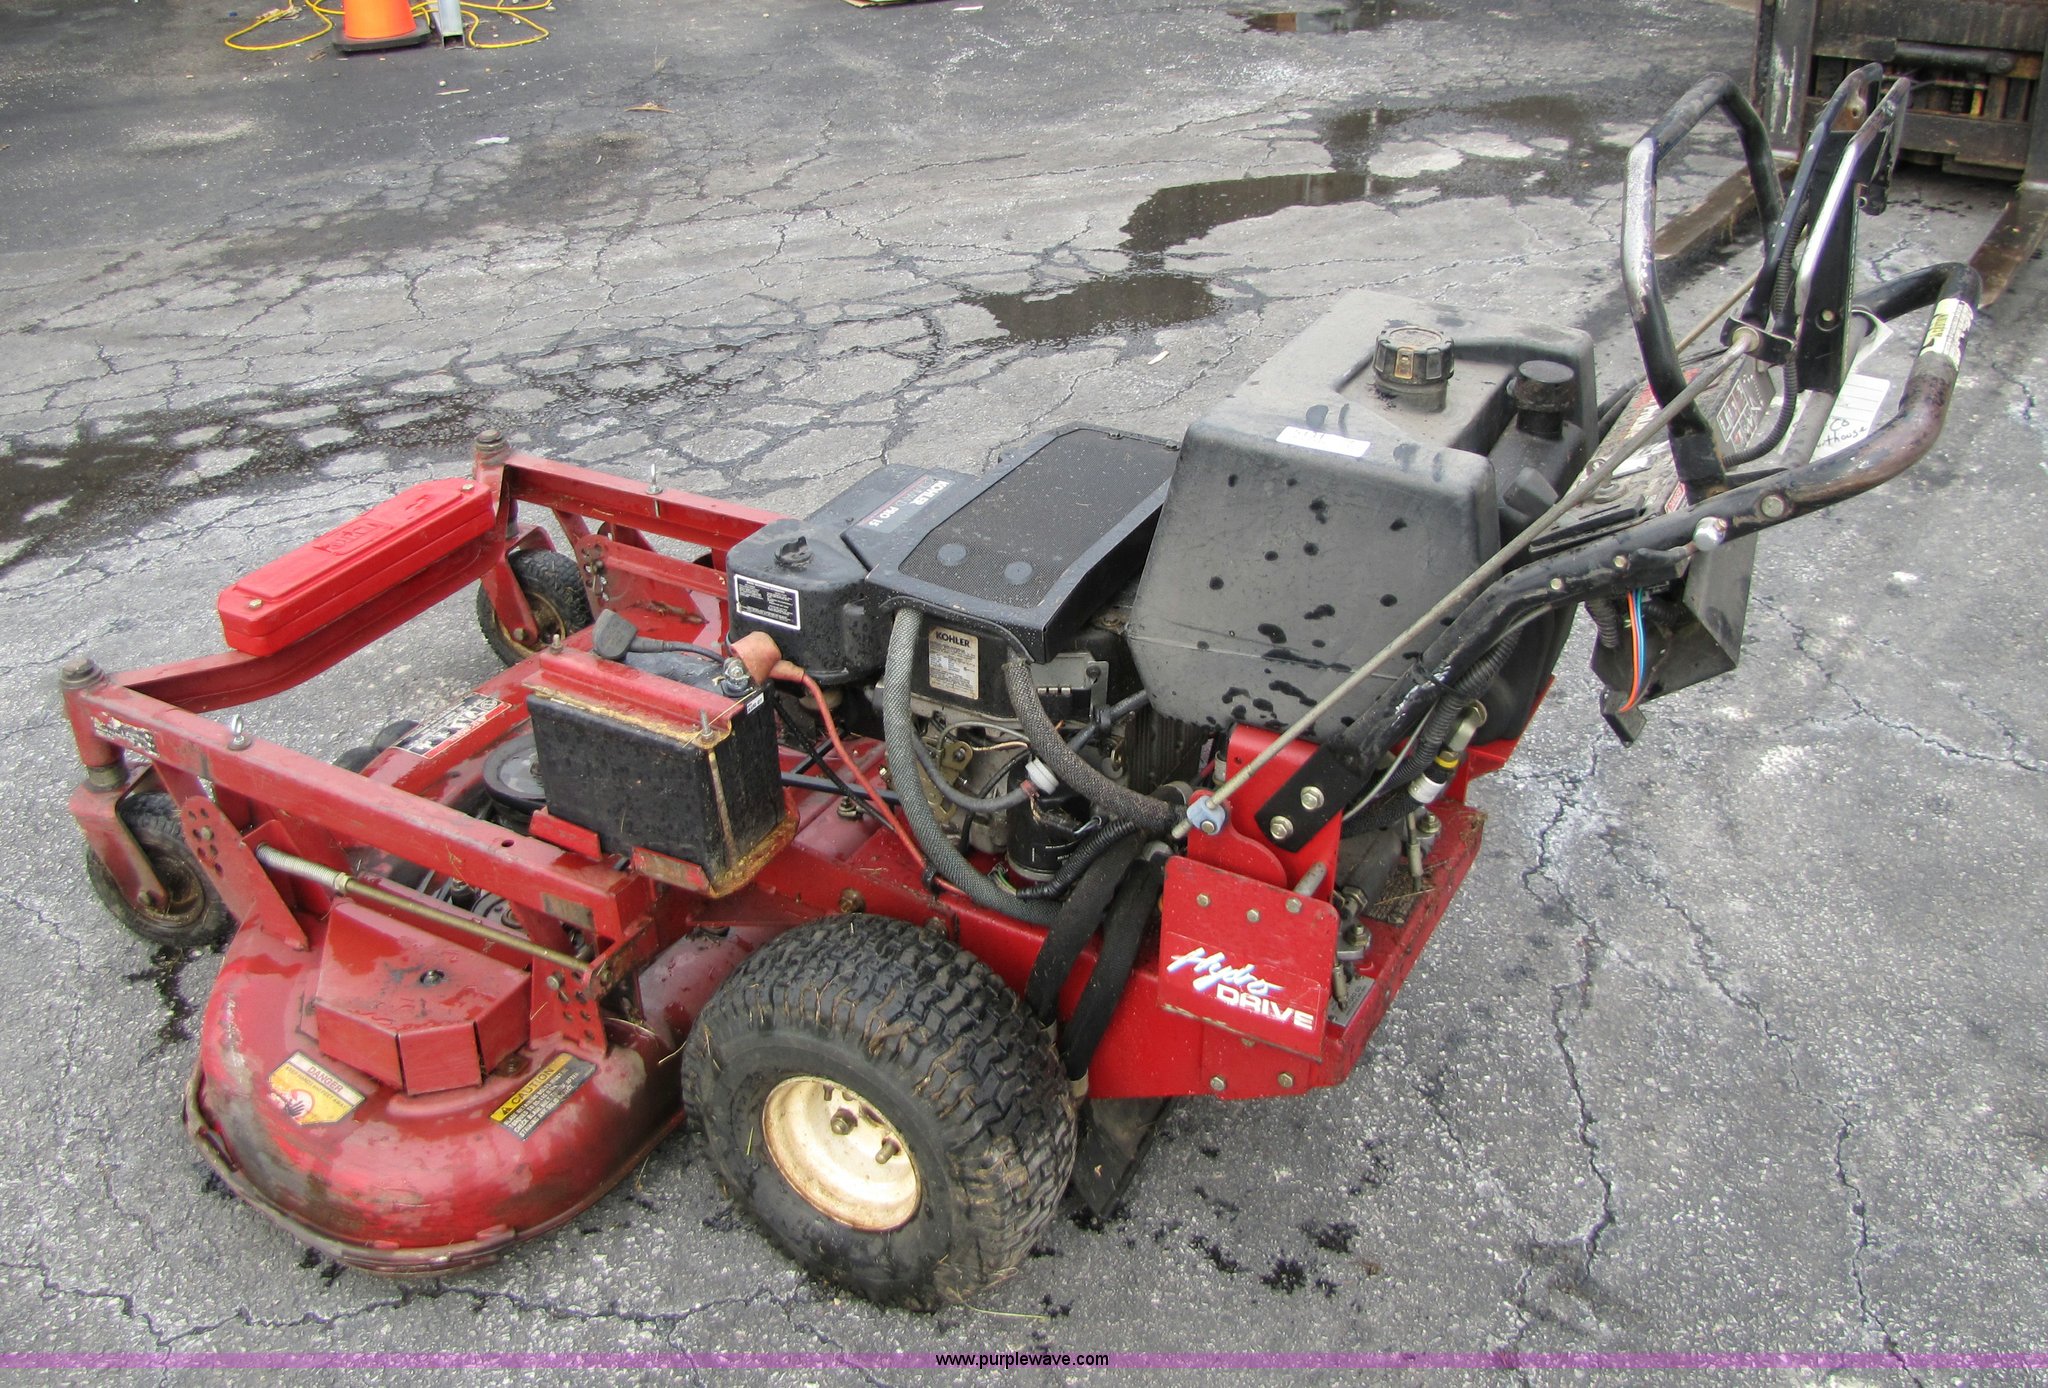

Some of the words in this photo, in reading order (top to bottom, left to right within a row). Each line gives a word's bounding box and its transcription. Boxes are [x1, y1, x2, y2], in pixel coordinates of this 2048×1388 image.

[909, 480, 951, 505] KOHLER
[879, 506, 899, 520] PRO
[935, 631, 970, 648] KOHLER
[1166, 947, 1285, 995] Hydro
[1216, 983, 1314, 1031] DRIVE
[307, 1065, 344, 1093] DANGER
[510, 1067, 554, 1105] CAUTION
